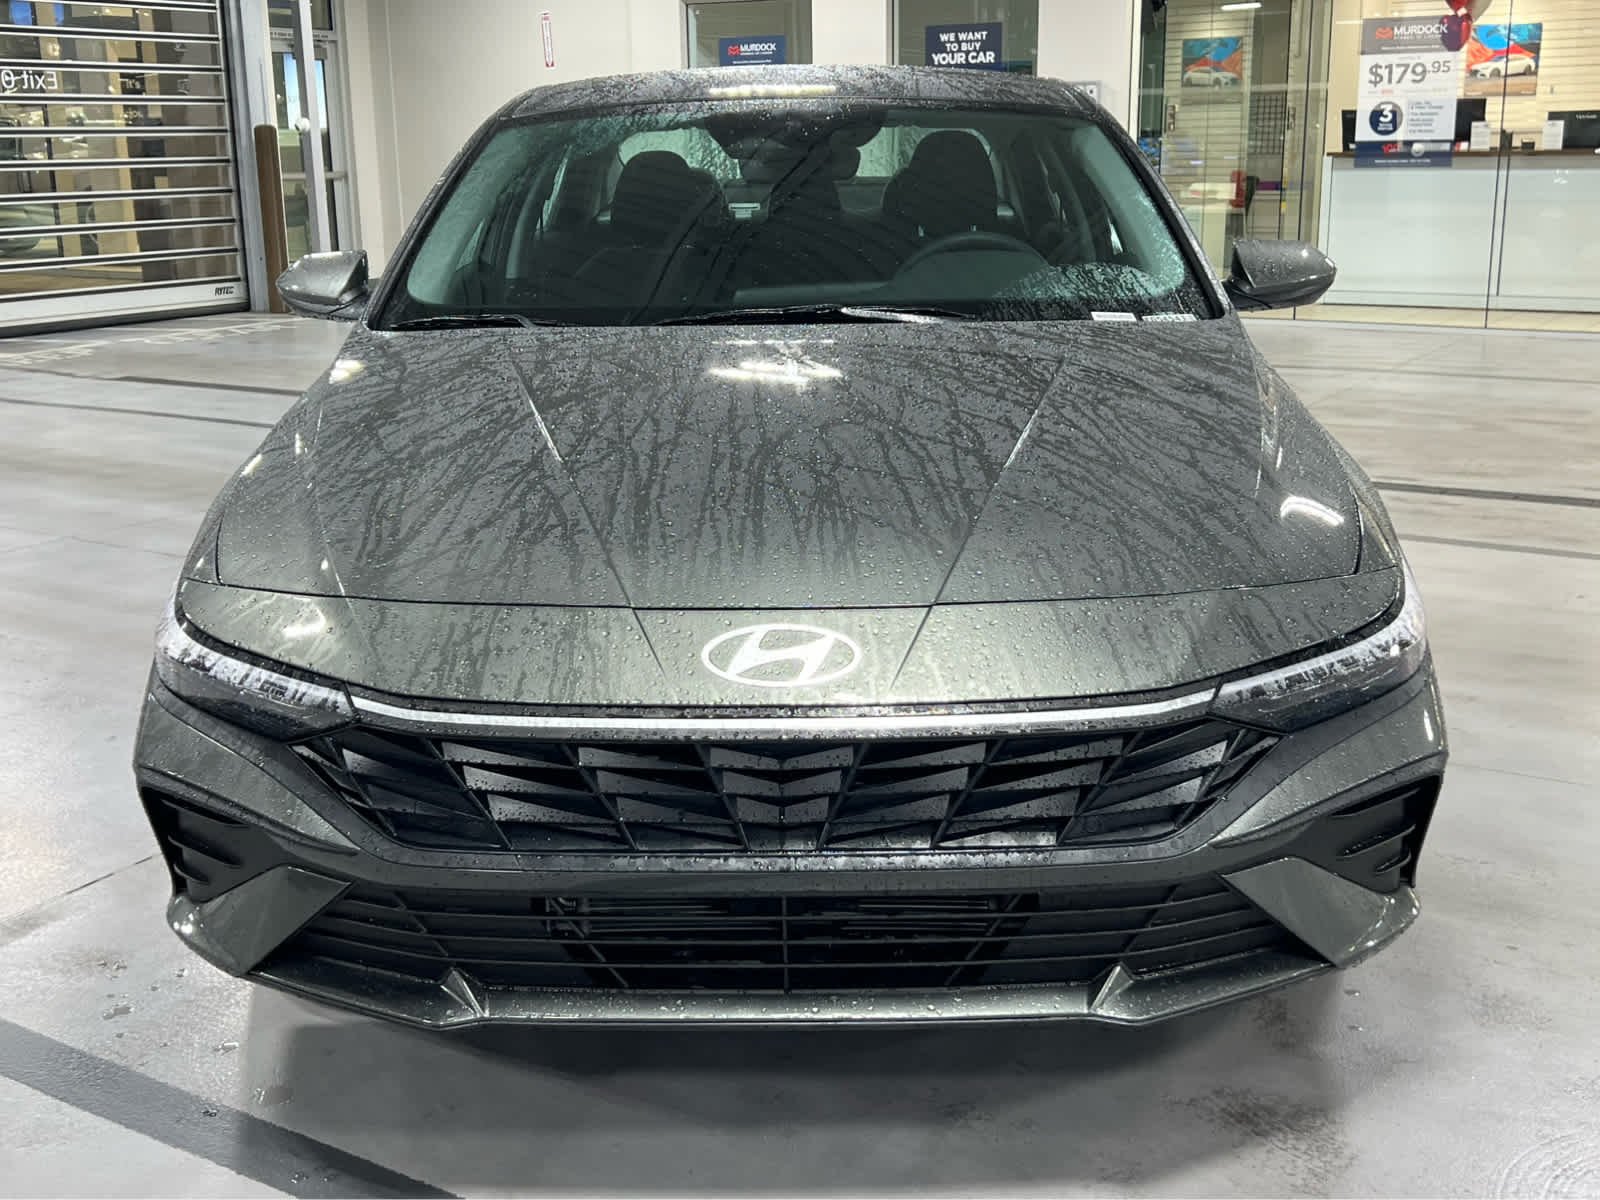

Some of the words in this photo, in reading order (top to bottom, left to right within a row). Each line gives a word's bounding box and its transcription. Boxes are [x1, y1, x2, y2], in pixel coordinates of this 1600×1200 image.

[1394, 24, 1448, 35] MURDOCK
[939, 33, 955, 42] WE
[958, 31, 988, 41] WANT
[945, 43, 959, 52] TO
[961, 41, 981, 51] BUY
[931, 52, 966, 65] YOUR
[968, 51, 995, 64] CAR
[1379, 104, 1393, 122] 3
